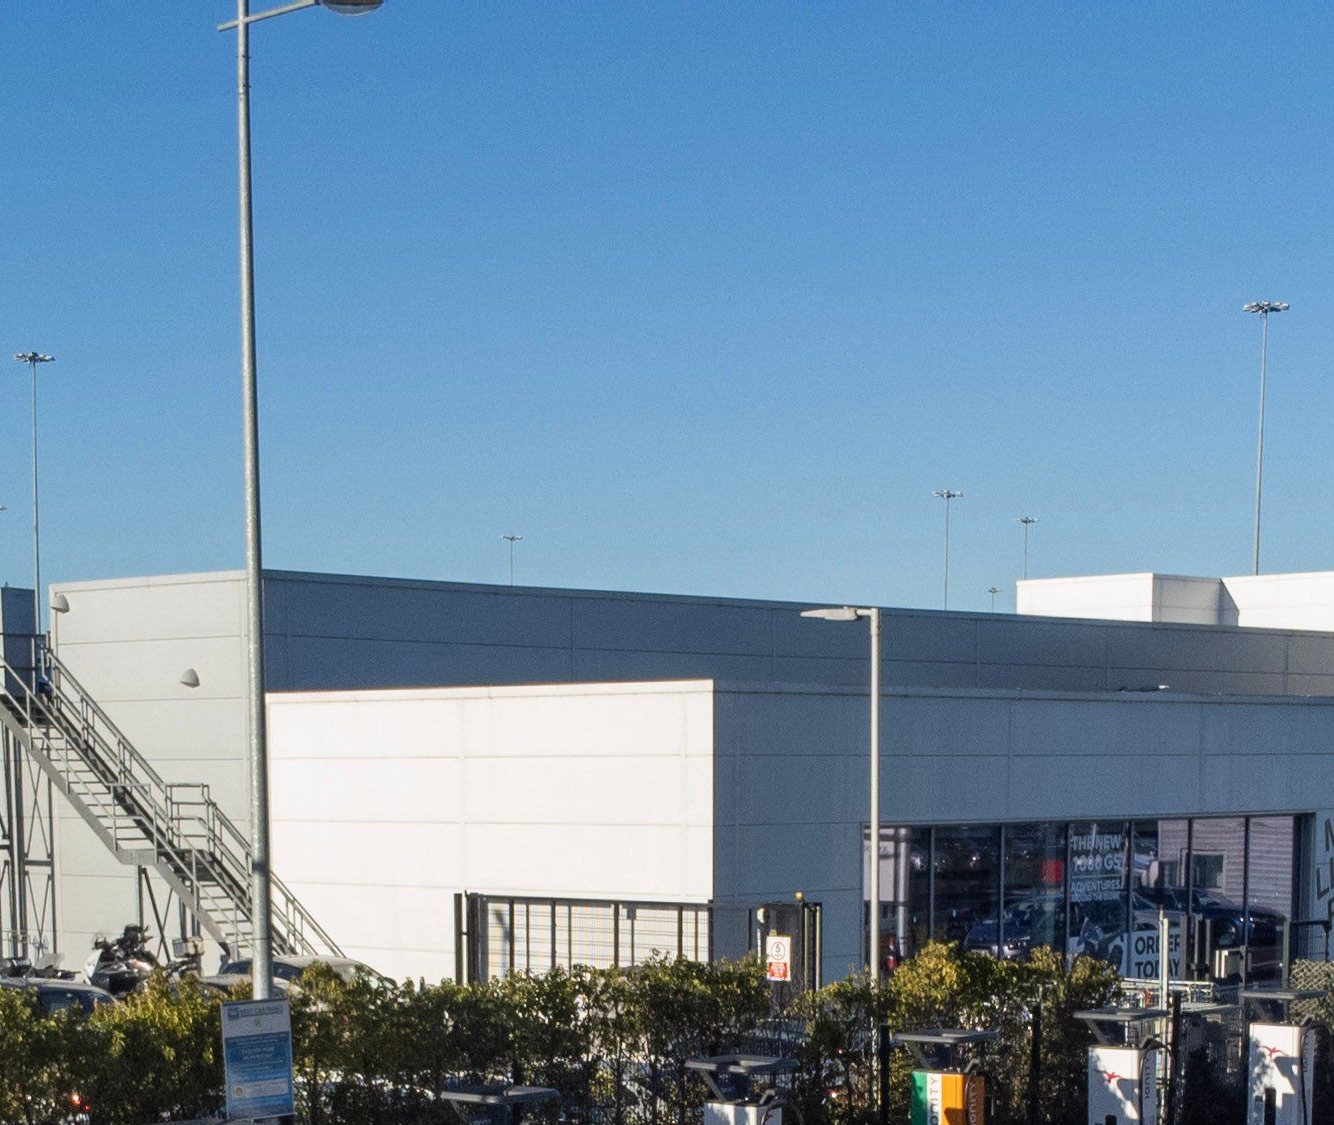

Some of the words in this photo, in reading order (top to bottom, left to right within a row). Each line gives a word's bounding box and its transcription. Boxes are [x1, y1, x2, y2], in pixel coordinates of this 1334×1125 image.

[1072, 836, 1093, 851] THE
[1094, 834, 1121, 850] NEW
[775, 943, 781, 953] 5
[1134, 933, 1181, 956] ORER
[1134, 959, 1180, 979] TOAY
